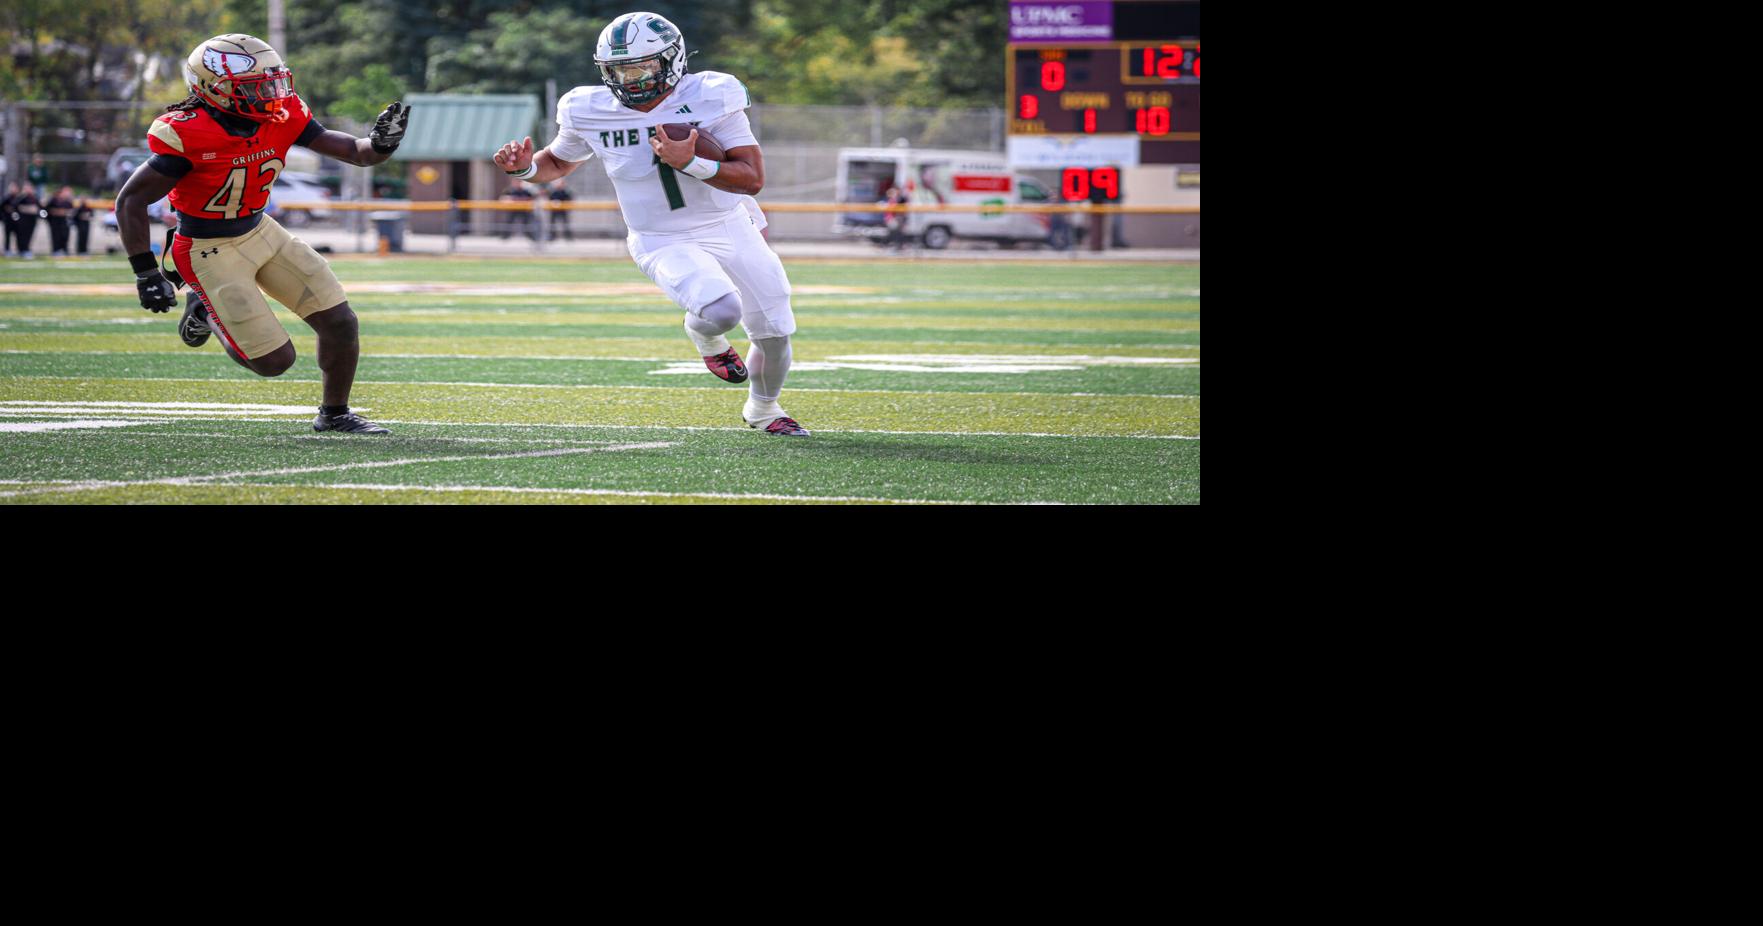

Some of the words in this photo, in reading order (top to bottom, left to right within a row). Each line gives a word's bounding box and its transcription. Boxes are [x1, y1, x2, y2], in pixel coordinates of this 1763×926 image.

[1041, 61, 1065, 91] 0
[1084, 108, 1096, 134] 1
[1136, 106, 1170, 135] 10
[600, 128, 640, 148] THE
[232, 148, 276, 166] GRIFFINS
[202, 158, 285, 219] 43
[1062, 167, 1118, 201] 09
